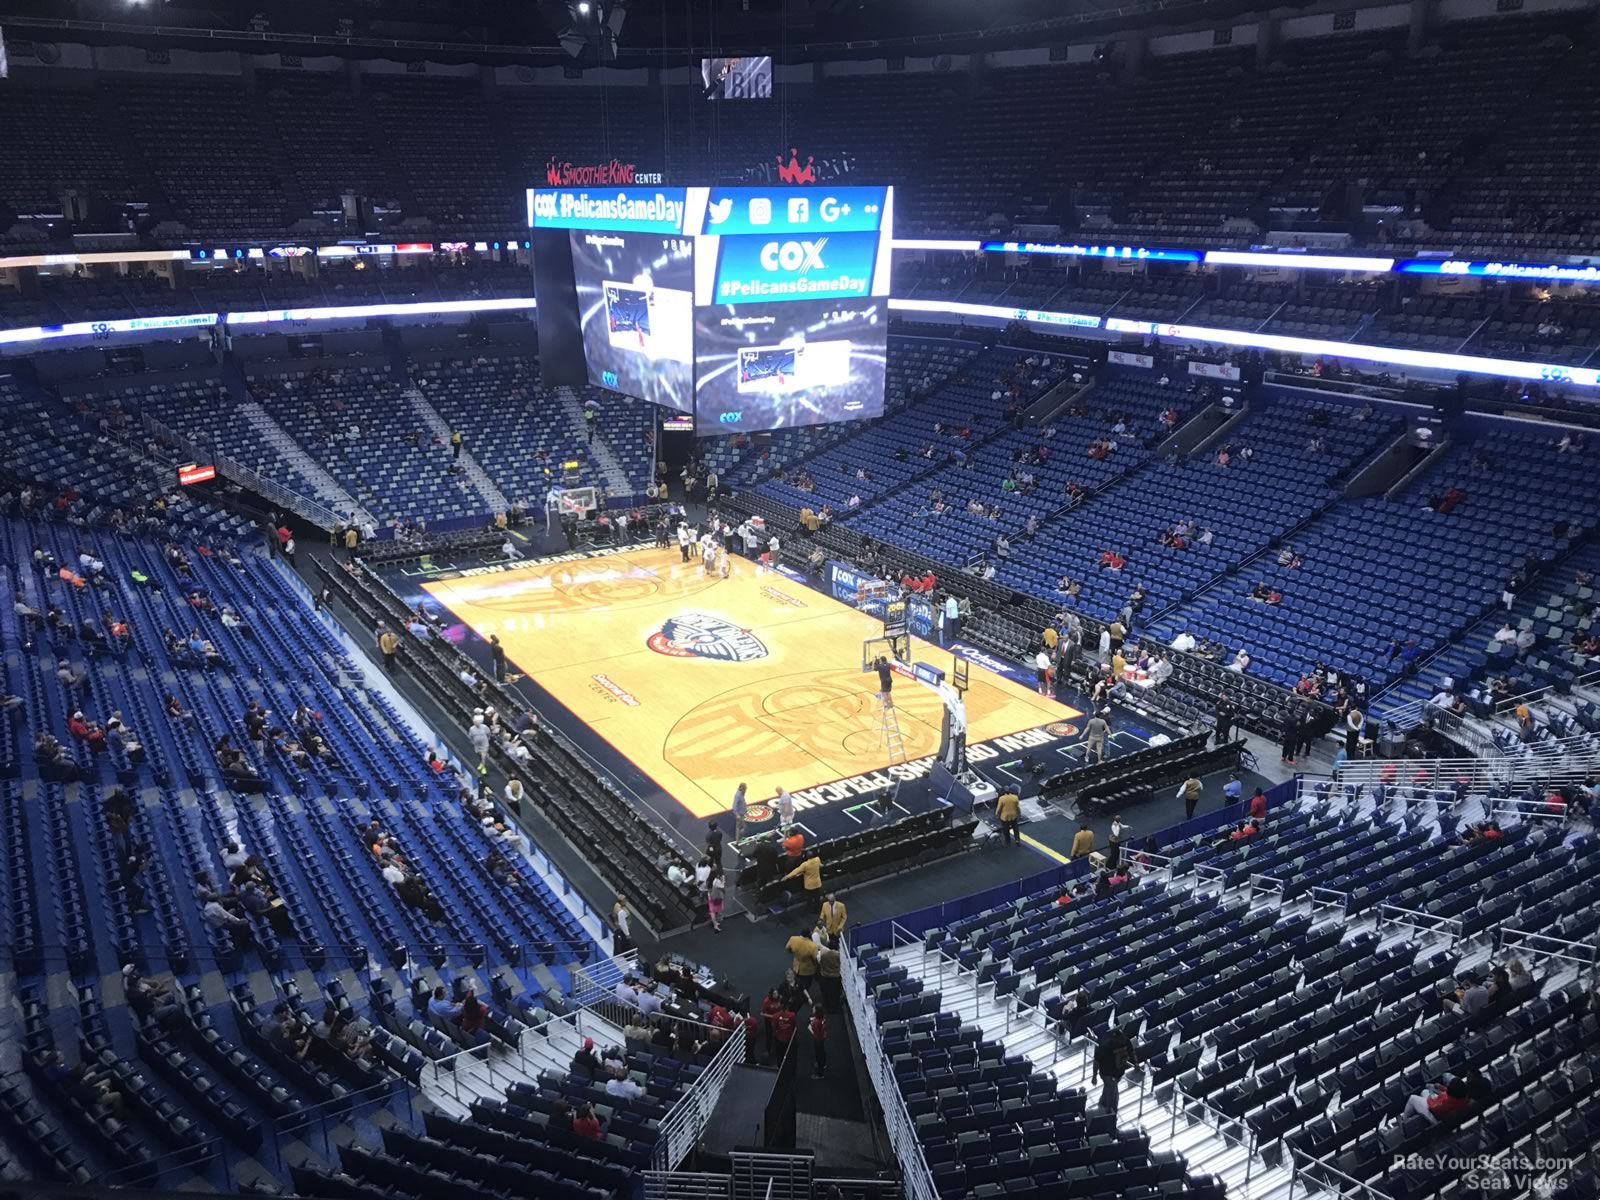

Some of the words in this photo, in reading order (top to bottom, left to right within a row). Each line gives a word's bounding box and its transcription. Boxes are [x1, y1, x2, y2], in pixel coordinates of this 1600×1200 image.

[635, 173, 662, 184] CENTER
[534, 192, 559, 220] COX
[560, 193, 683, 229] #PelicansGameDay
[760, 237, 829, 275] COX
[721, 275, 867, 297] #PelicansGameDay
[719, 411, 743, 424] COX
[460, 563, 505, 577] NEW
[590, 540, 659, 558] PELICAN
[993, 728, 1058, 753] NEW
